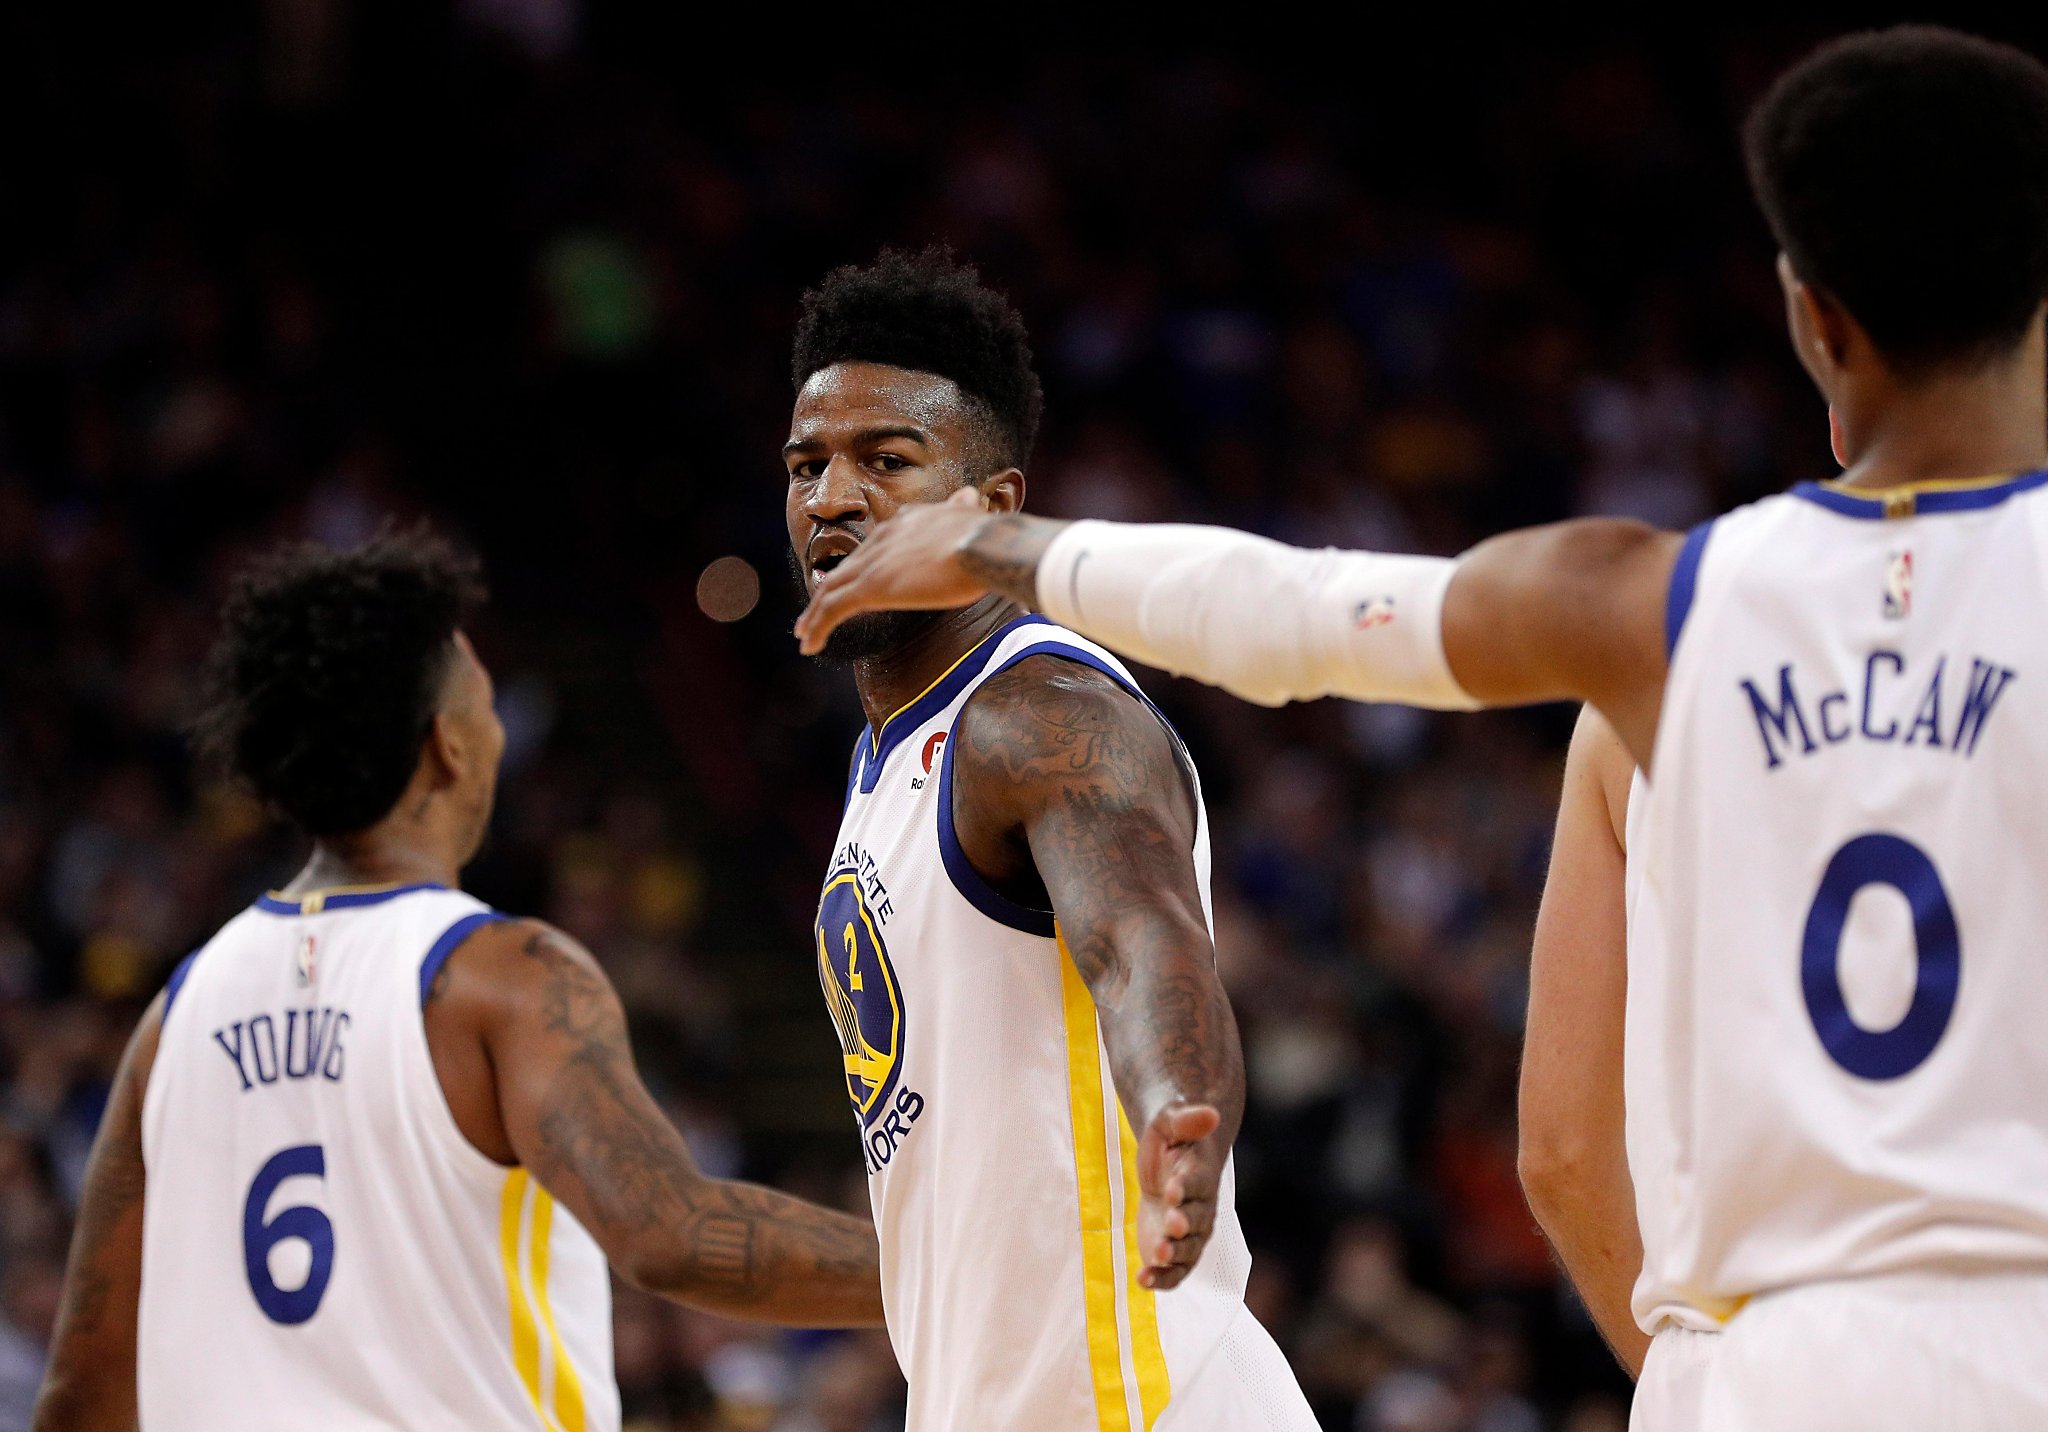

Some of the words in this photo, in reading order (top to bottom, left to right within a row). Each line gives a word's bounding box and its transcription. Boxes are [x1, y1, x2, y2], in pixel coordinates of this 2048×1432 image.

[1739, 650, 2017, 768] McCAW
[859, 850, 894, 926] STATE
[842, 921, 864, 994] 2
[1801, 833, 1961, 1081] 0
[243, 1144, 334, 1326] 6
